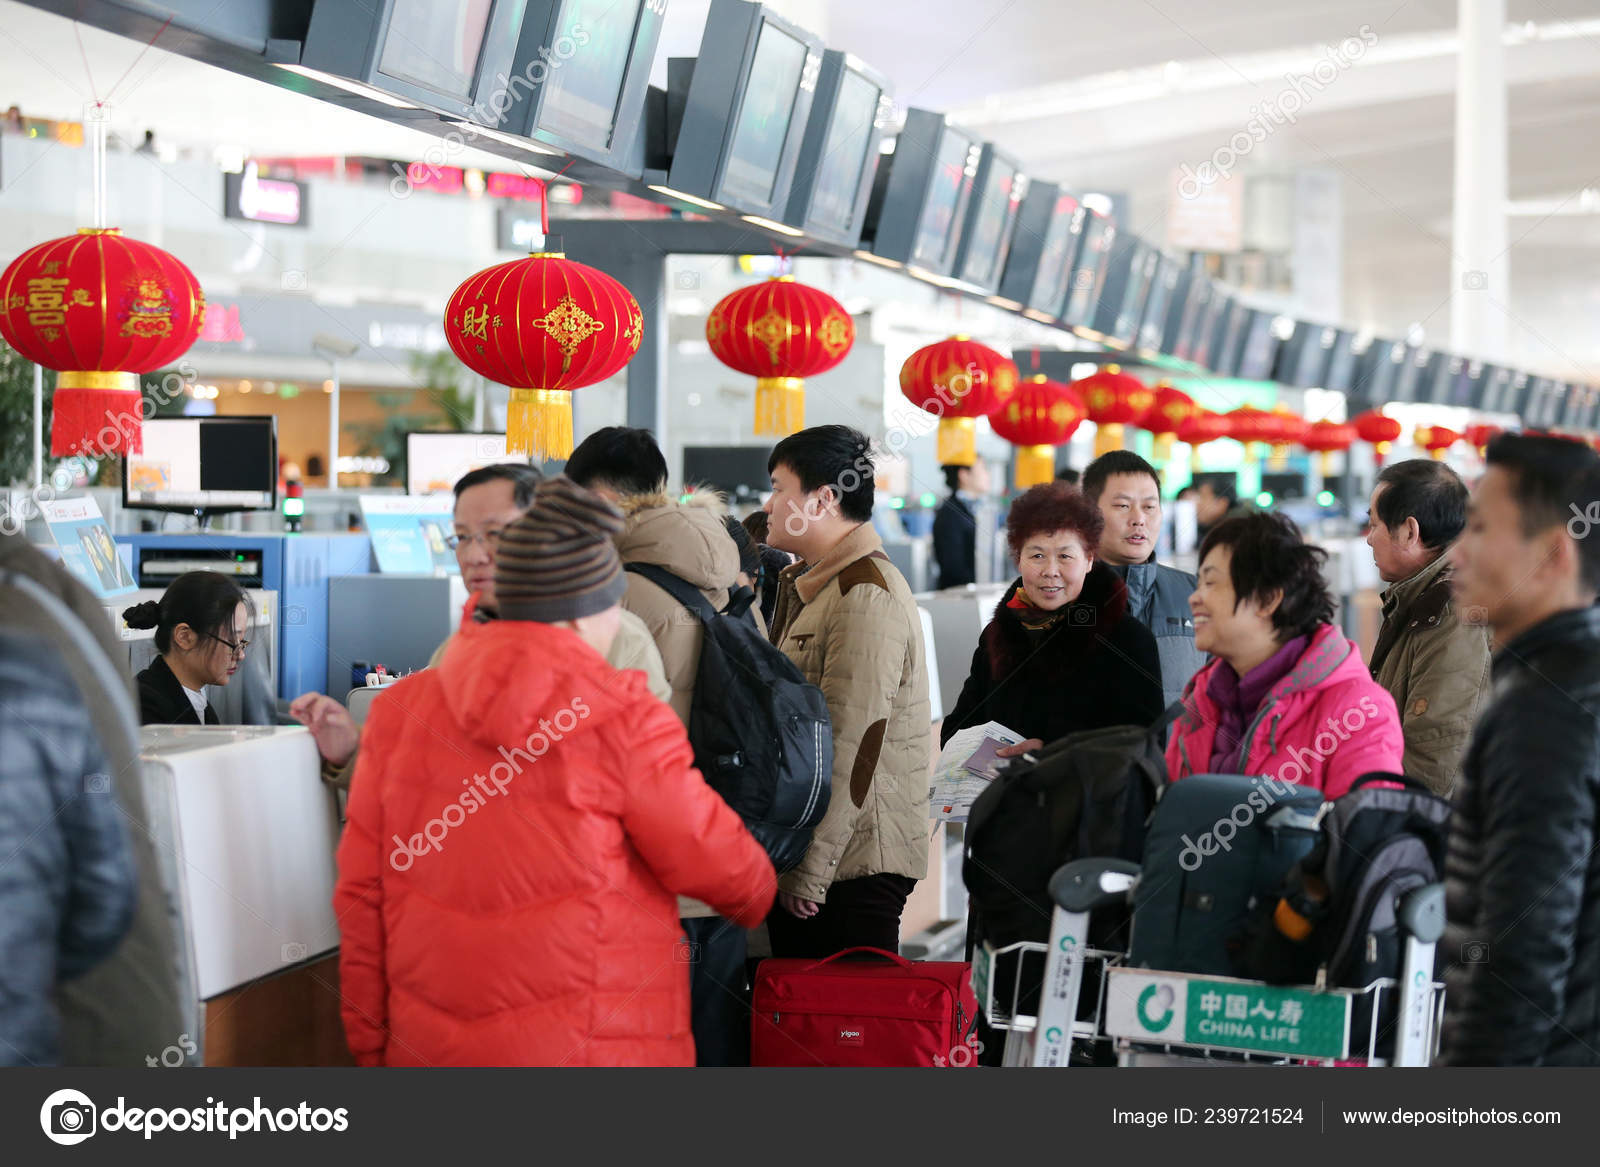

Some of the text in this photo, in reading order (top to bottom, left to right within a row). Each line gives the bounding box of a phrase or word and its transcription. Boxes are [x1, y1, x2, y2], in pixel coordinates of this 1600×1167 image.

[1199, 990, 1304, 1026] 中国人寿
[1198, 1020, 1302, 1044] CHINA LIFE
